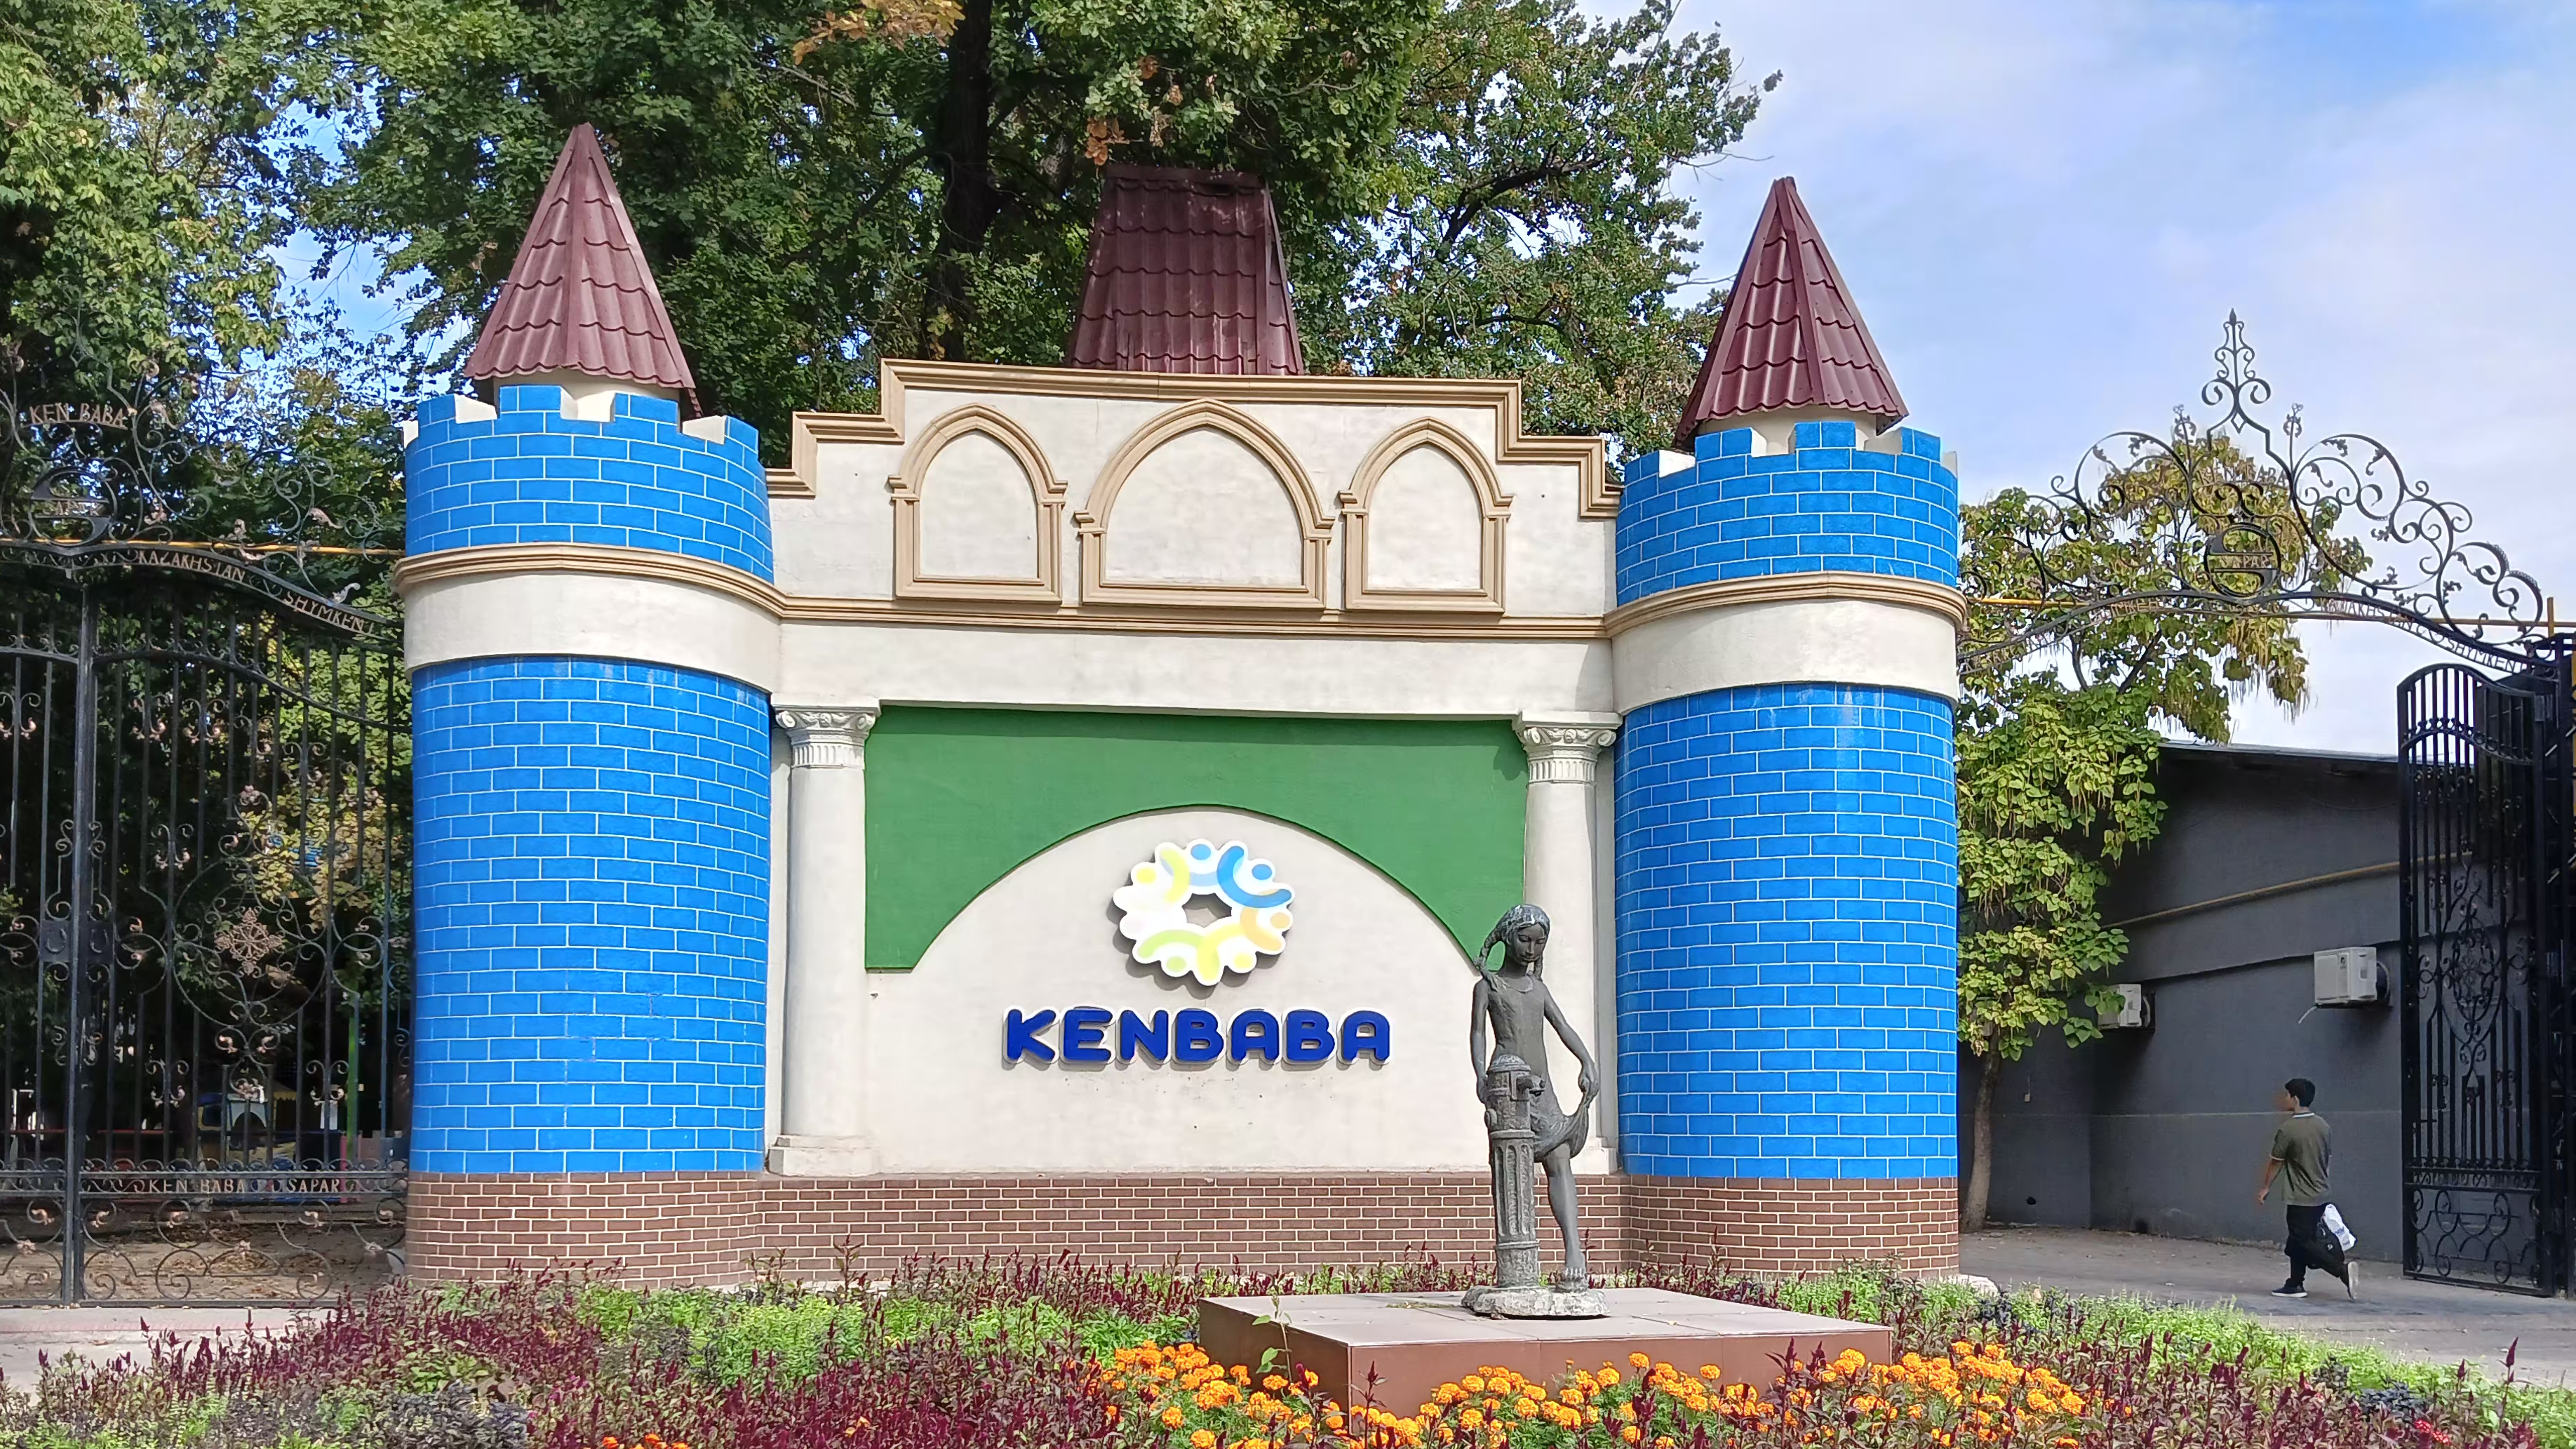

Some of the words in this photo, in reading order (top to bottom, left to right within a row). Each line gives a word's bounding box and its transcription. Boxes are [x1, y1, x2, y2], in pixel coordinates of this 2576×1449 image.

[29, 402, 69, 422] KEN
[79, 403, 125, 427] BABA
[139, 550, 246, 583] KAZAKHSTAN
[283, 591, 375, 634] SHYMKENT
[1005, 1007, 1392, 1064] KENBABA
[149, 1178, 188, 1193] KEN
[200, 1178, 246, 1193] BABA
[286, 1178, 340, 1193] SAPAR
